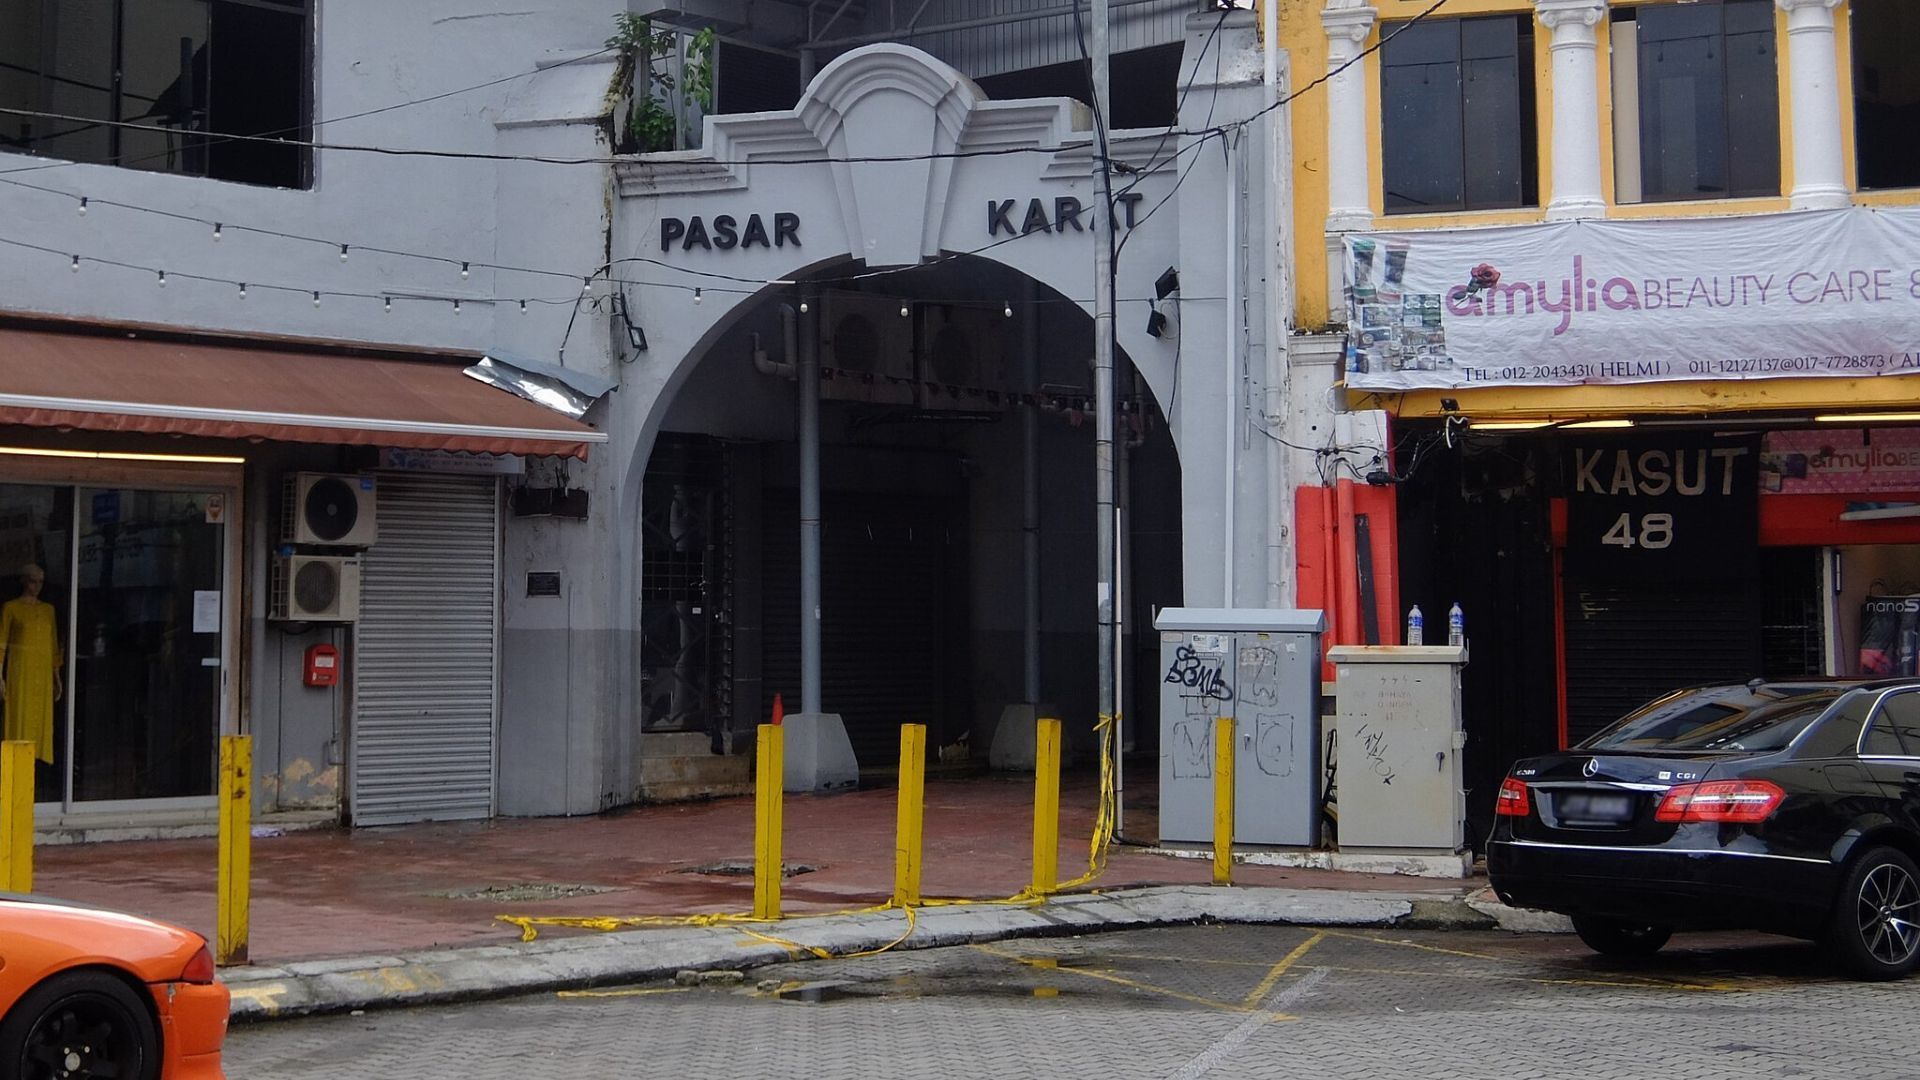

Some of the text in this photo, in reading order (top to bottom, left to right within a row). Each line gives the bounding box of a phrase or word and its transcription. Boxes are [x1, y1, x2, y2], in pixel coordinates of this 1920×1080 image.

[661, 193, 1143, 252] PASAR KART
[1644, 274, 1774, 309] BEAUTY
[1787, 270, 1893, 304] CARE
[1575, 447, 1749, 497] KASUT
[1602, 512, 1673, 549] 48
